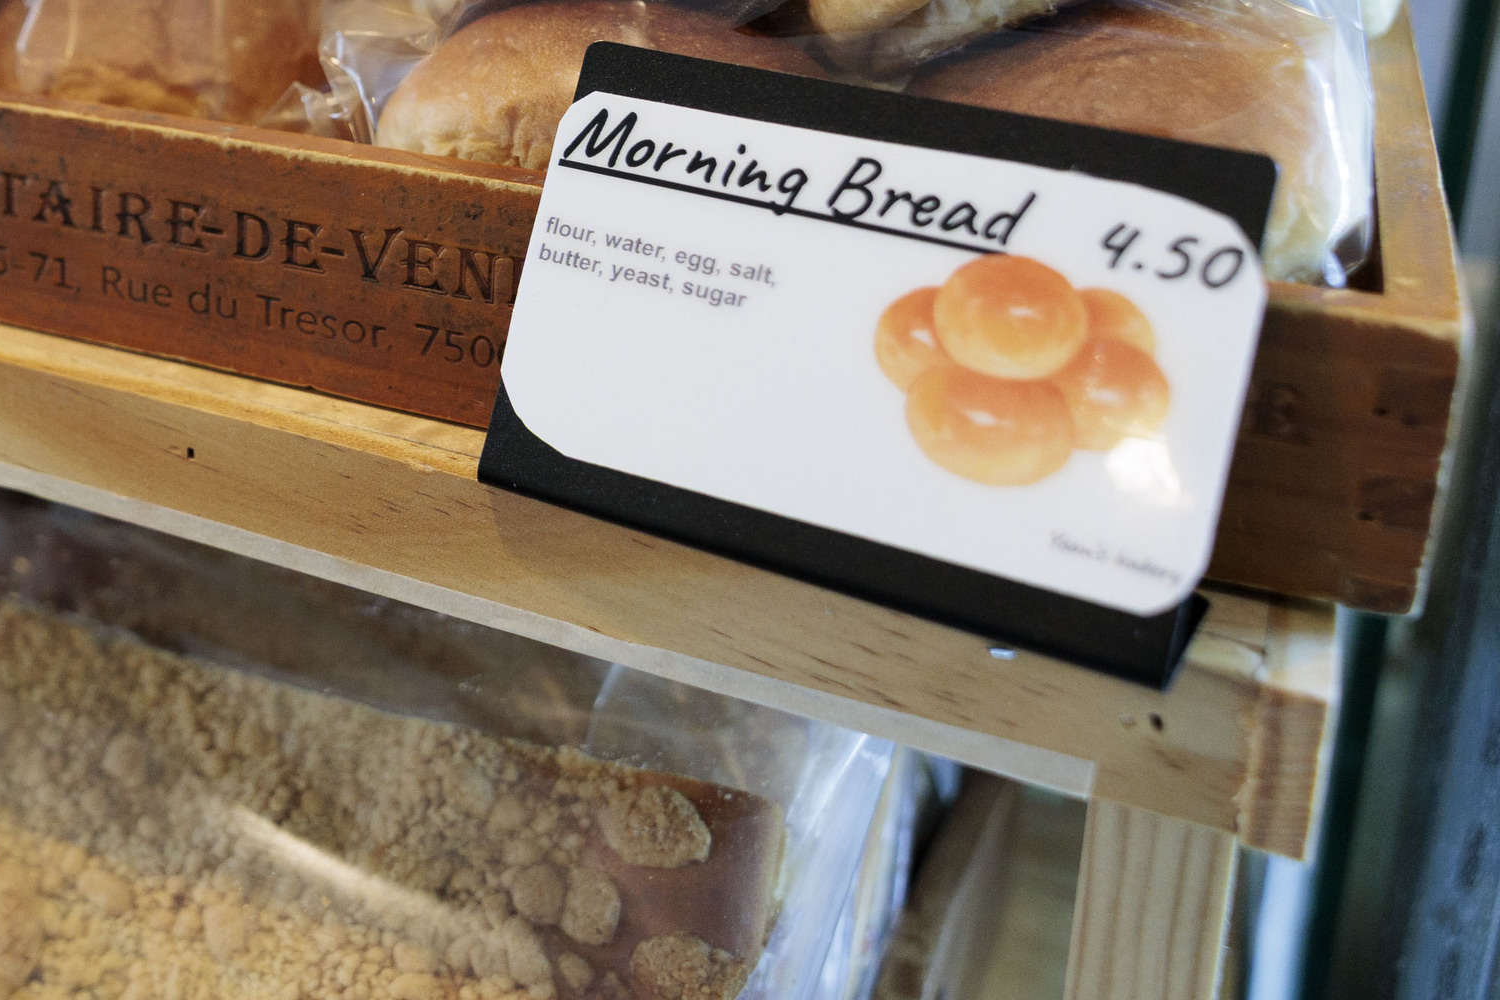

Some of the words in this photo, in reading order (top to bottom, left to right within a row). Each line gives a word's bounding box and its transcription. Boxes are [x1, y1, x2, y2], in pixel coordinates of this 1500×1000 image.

[562, 107, 809, 216] Morning
[826, 157, 1037, 248] Bread
[538, 243, 603, 277] butter,
[609, 263, 674, 294] yeast,
[681, 281, 748, 308] sugar
[545, 216, 597, 246] flour,
[605, 232, 666, 262] water,
[675, 250, 721, 276] egg,
[729, 262, 776, 288] salt,
[1098, 221, 1246, 291] 4.50
[102, 266, 173, 308] Rue
[188, 284, 238, 320] du
[415, 323, 505, 370] 750
